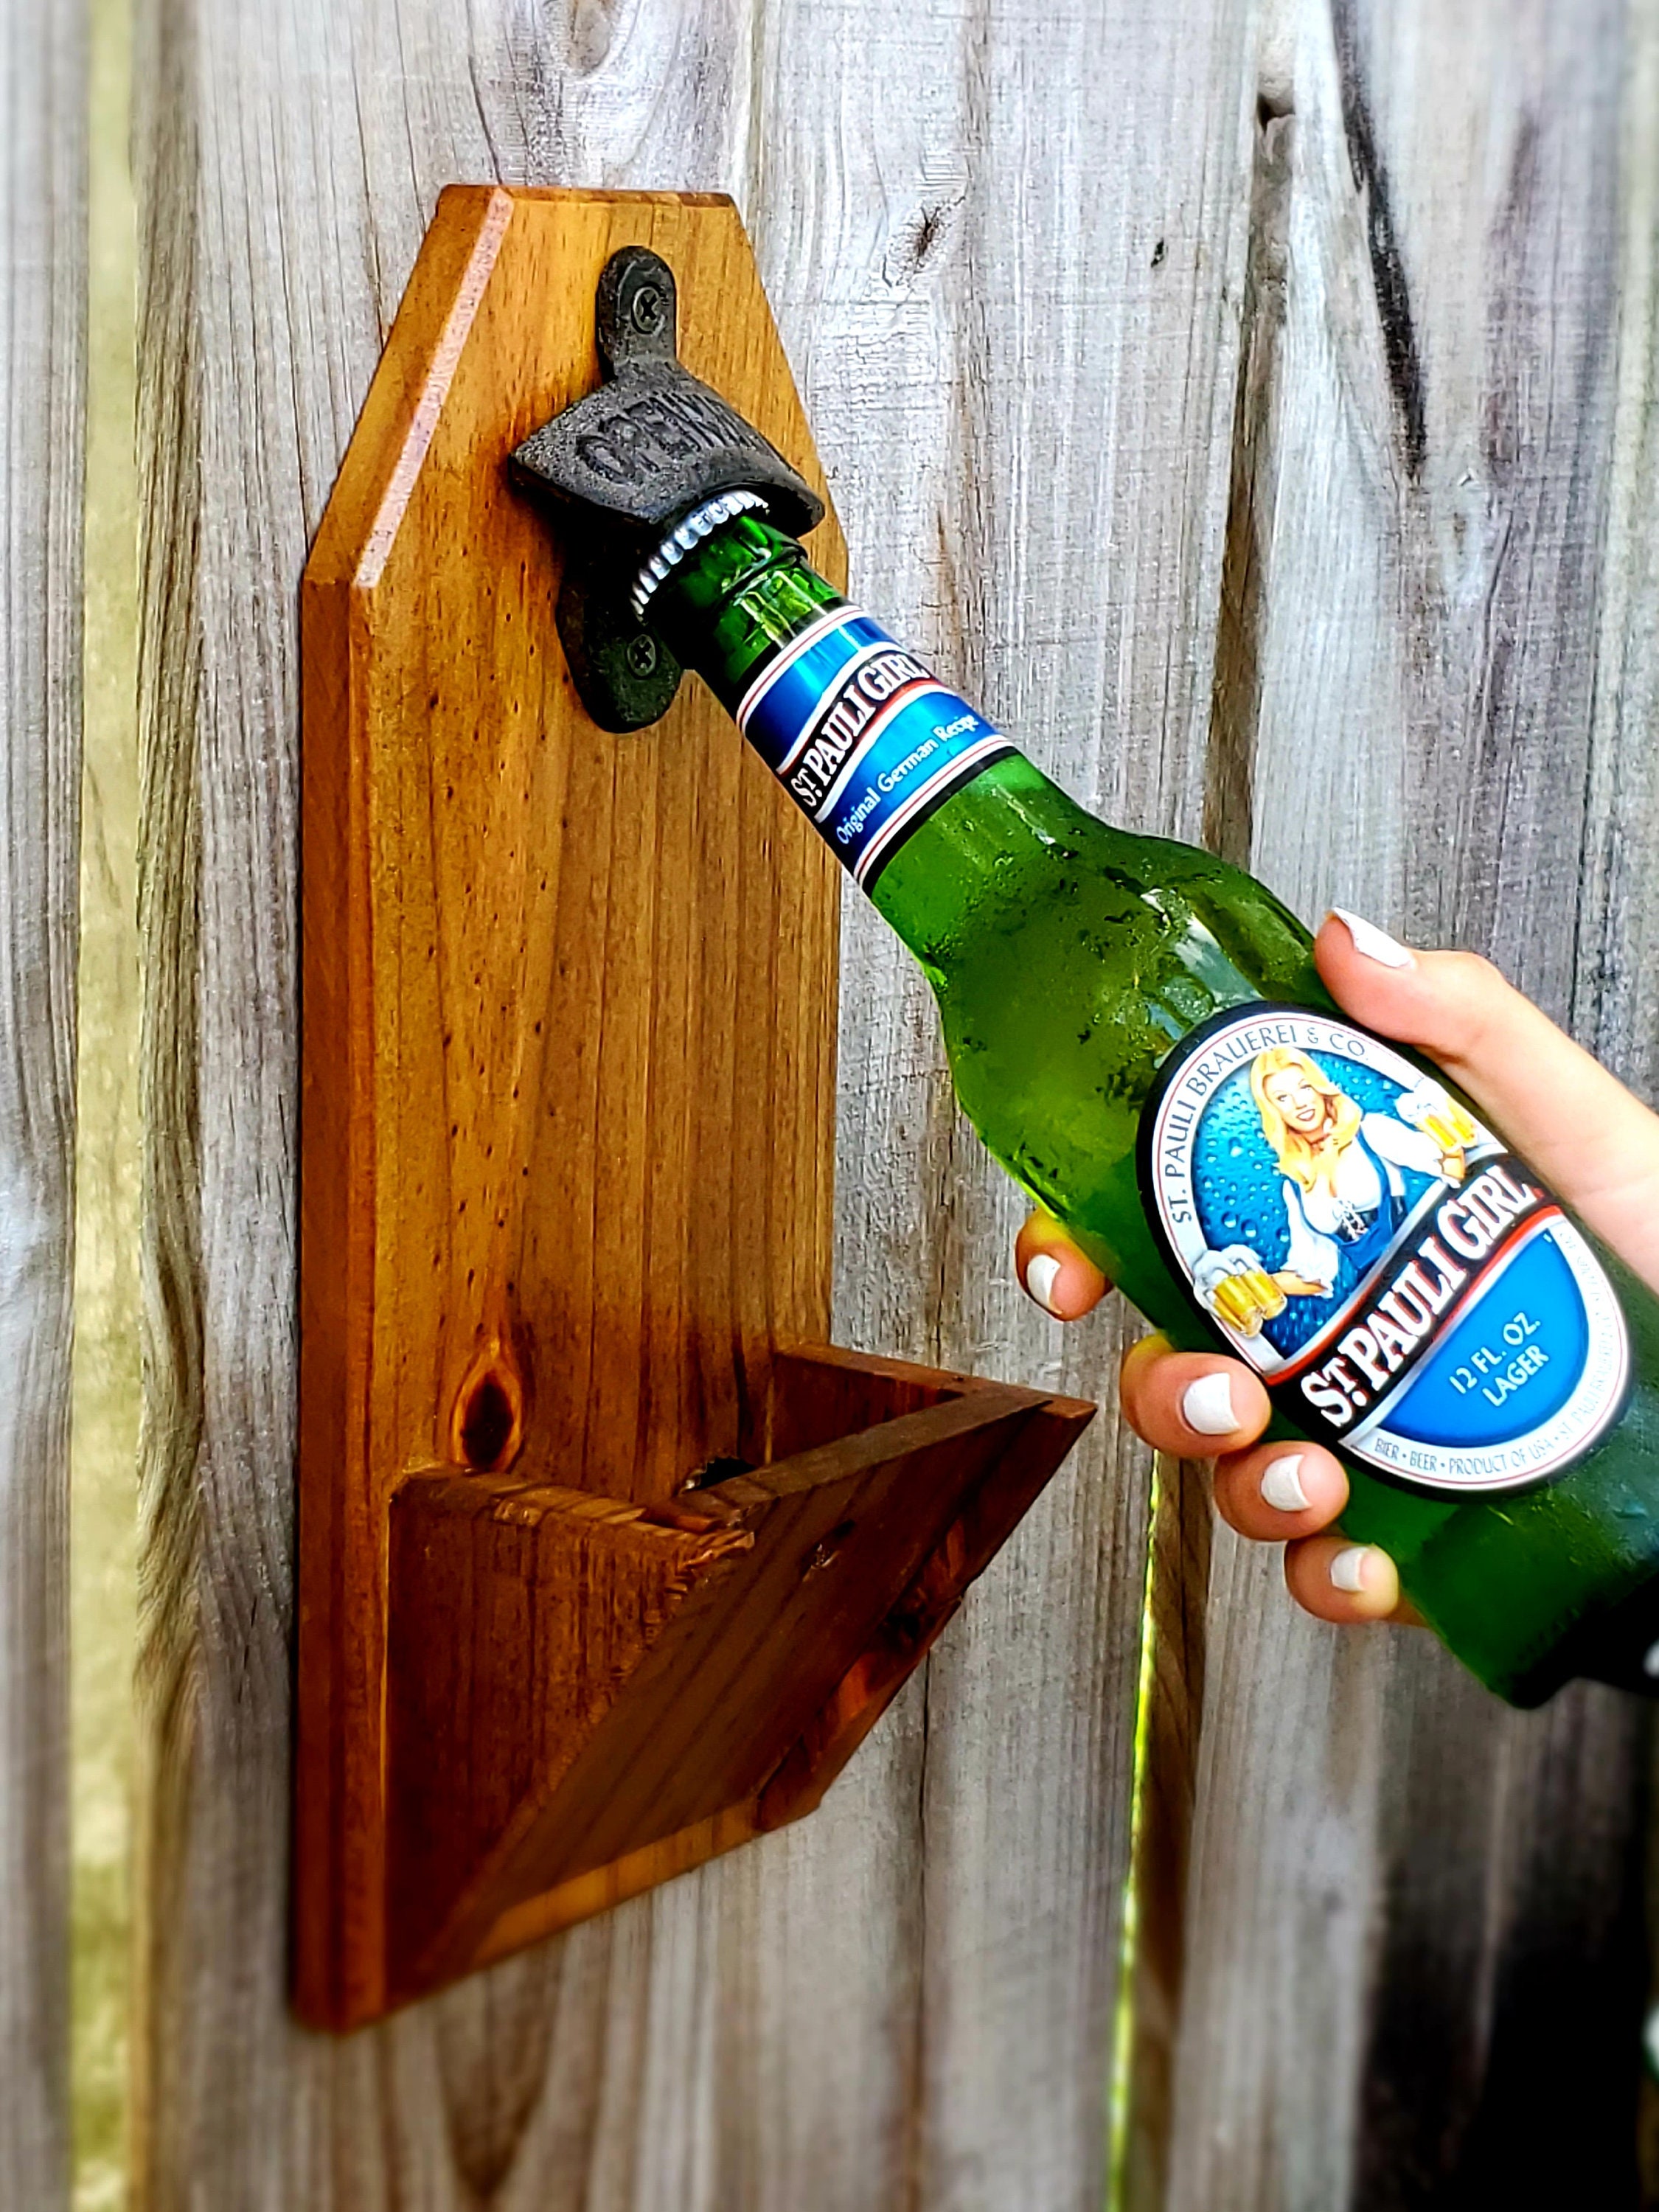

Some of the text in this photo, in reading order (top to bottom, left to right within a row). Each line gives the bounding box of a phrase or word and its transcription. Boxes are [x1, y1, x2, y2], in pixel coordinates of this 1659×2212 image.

[803, 684, 876, 787] PAULI
[857, 654, 931, 701] GIRL
[836, 787, 881, 844] Original
[877, 738, 939, 793] German
[1164, 1024, 1369, 1224] ST. PAULI BRAUEREI & CO.
[1337, 1235, 1468, 1391] PAULI
[1437, 1164, 1540, 1259] GIRL
[1449, 1312, 1541, 1394] 12 FL. OZ.
[1481, 1345, 1549, 1407] LAGER
[1374, 1437, 1399, 1460] BIER
[1409, 1450, 1437, 1472] BEER
[1449, 1453, 1507, 1475] PRODUCT
[1511, 1449, 1526, 1468] OF
